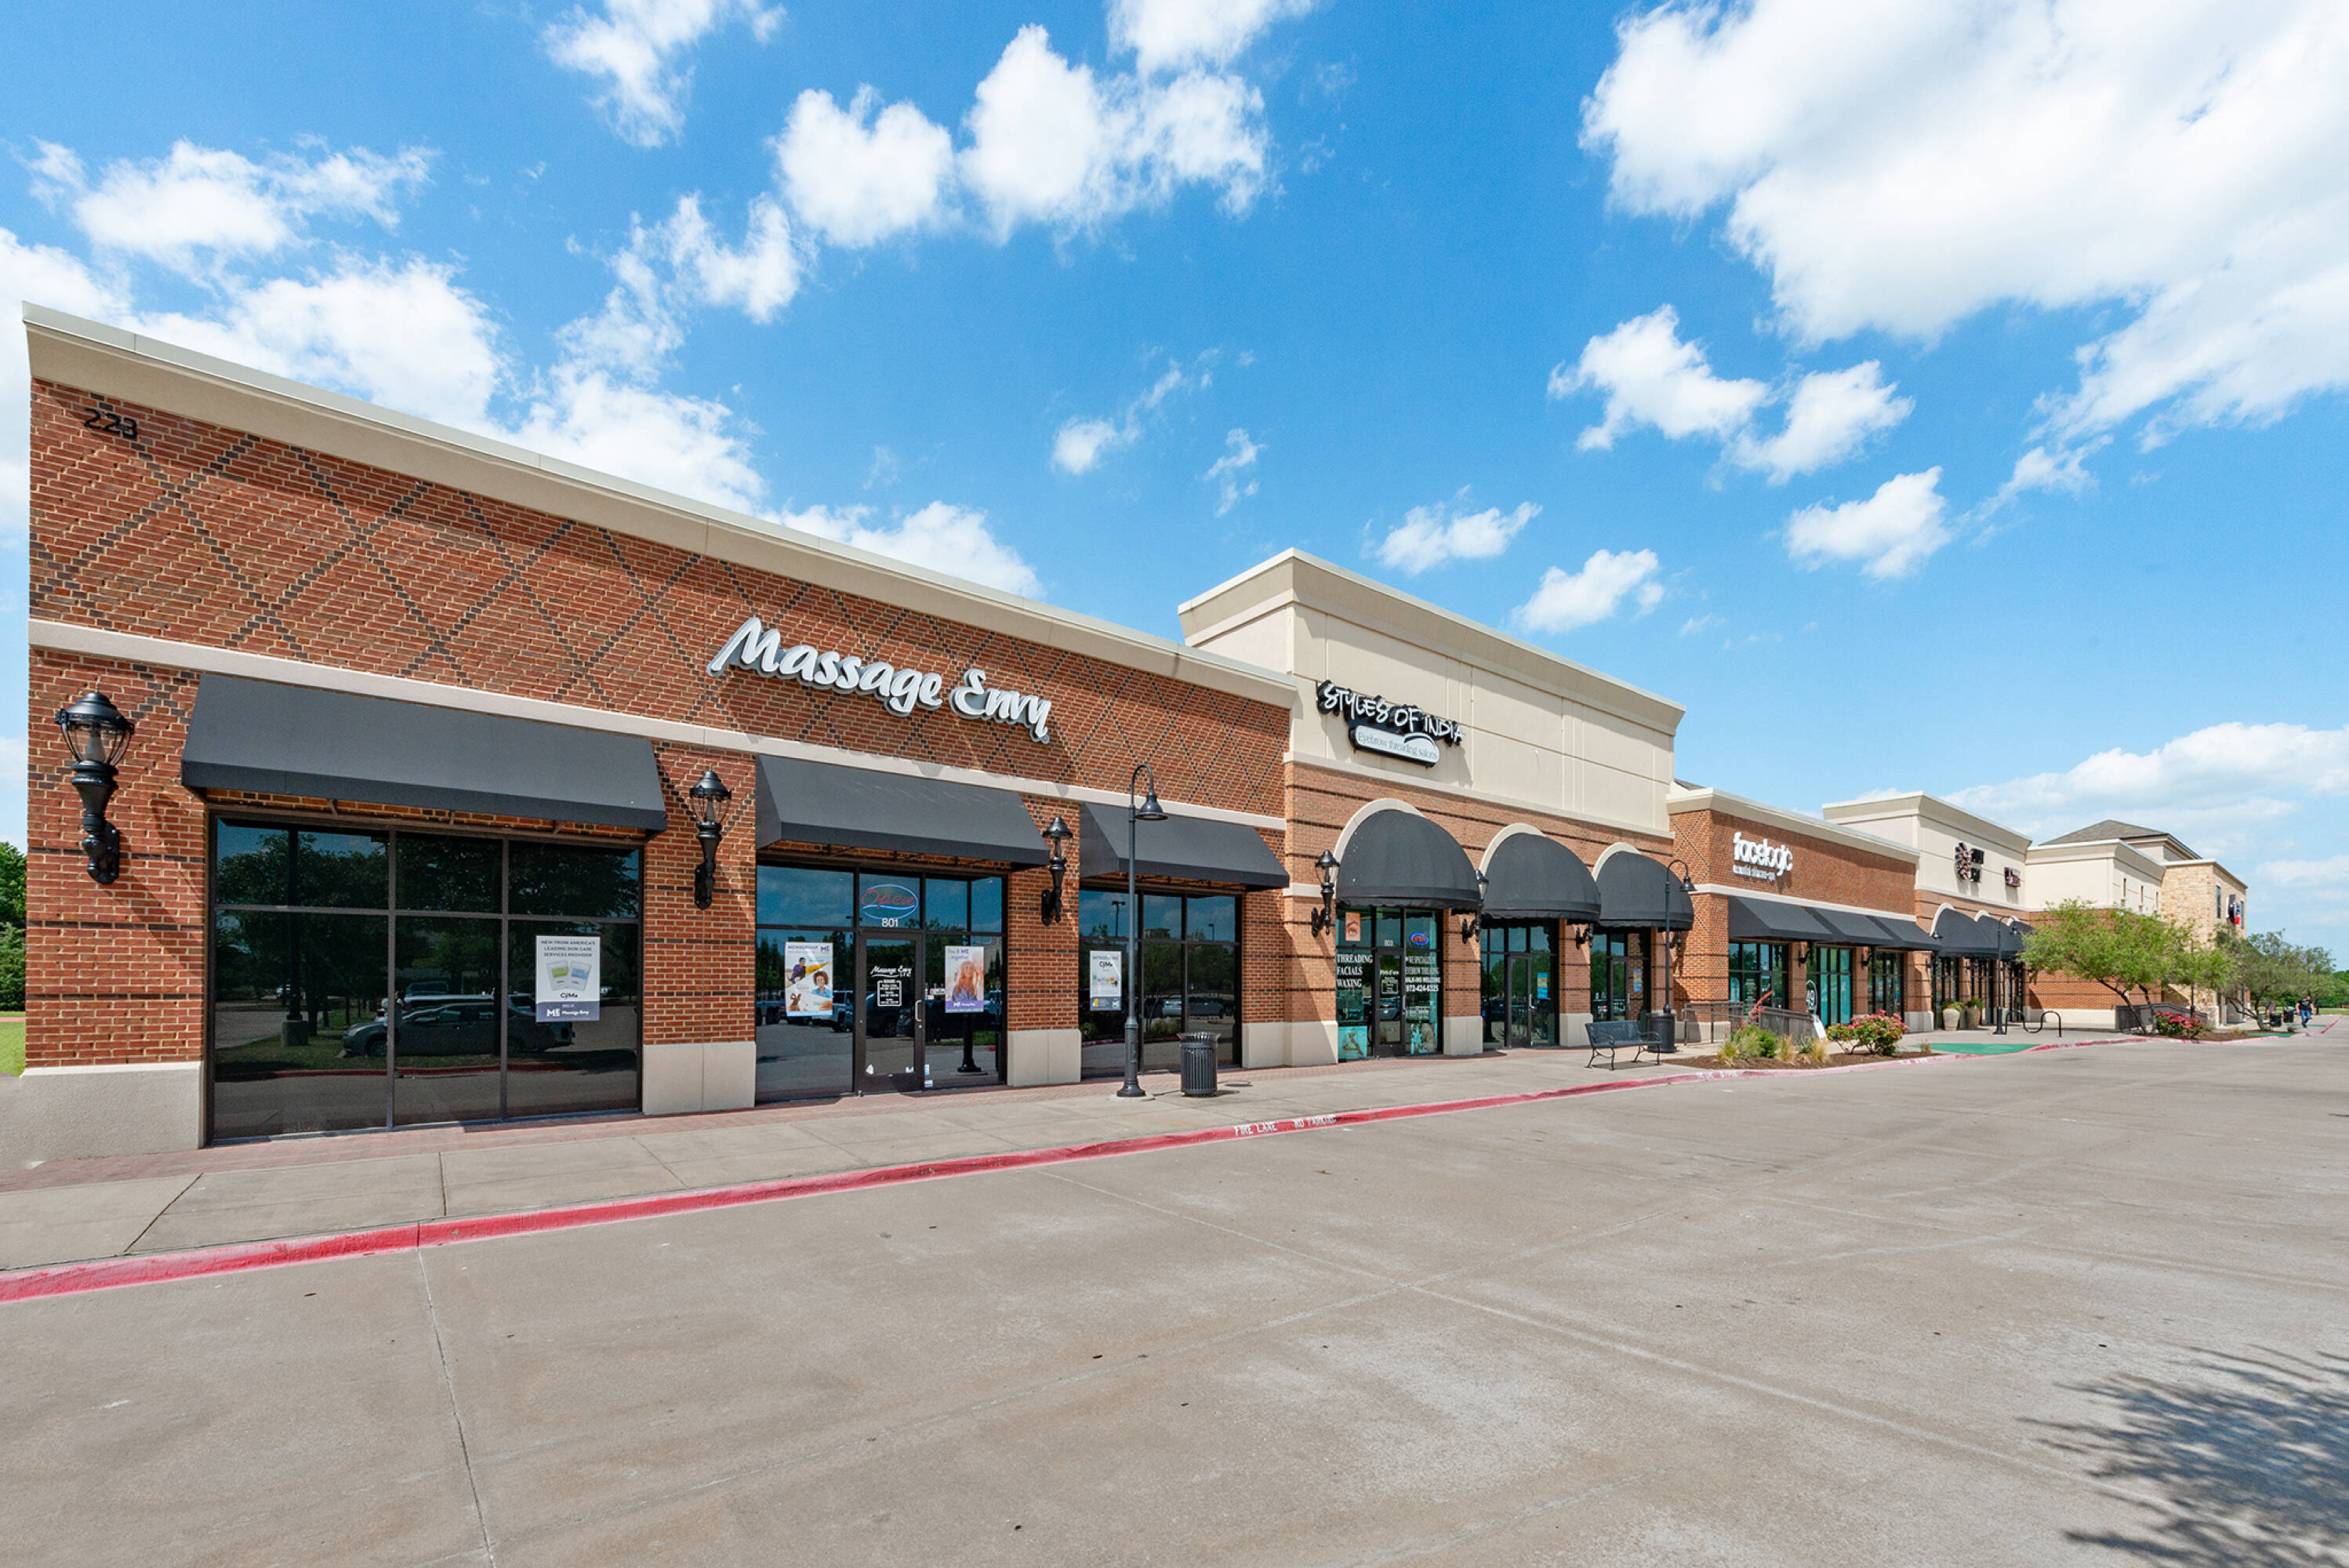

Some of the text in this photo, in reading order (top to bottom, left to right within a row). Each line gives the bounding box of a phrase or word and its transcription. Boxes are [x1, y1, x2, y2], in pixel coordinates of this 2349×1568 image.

[84, 408, 138, 438] 223
[708, 617, 1052, 739] Massage Envy
[1323, 683, 1465, 743] STYLES OF INDIA
[1357, 731, 1389, 748] Eyebrow
[1733, 832, 1793, 877] facelogic
[862, 888, 915, 909] Open
[881, 917, 899, 927] 801
[1336, 953, 1373, 964] THREADING
[1336, 966, 1363, 976] FACIALS
[1336, 978, 1362, 988] WAXING
[1233, 1123, 1254, 1136] FIRE
[1254, 1121, 1278, 1134] LANE
